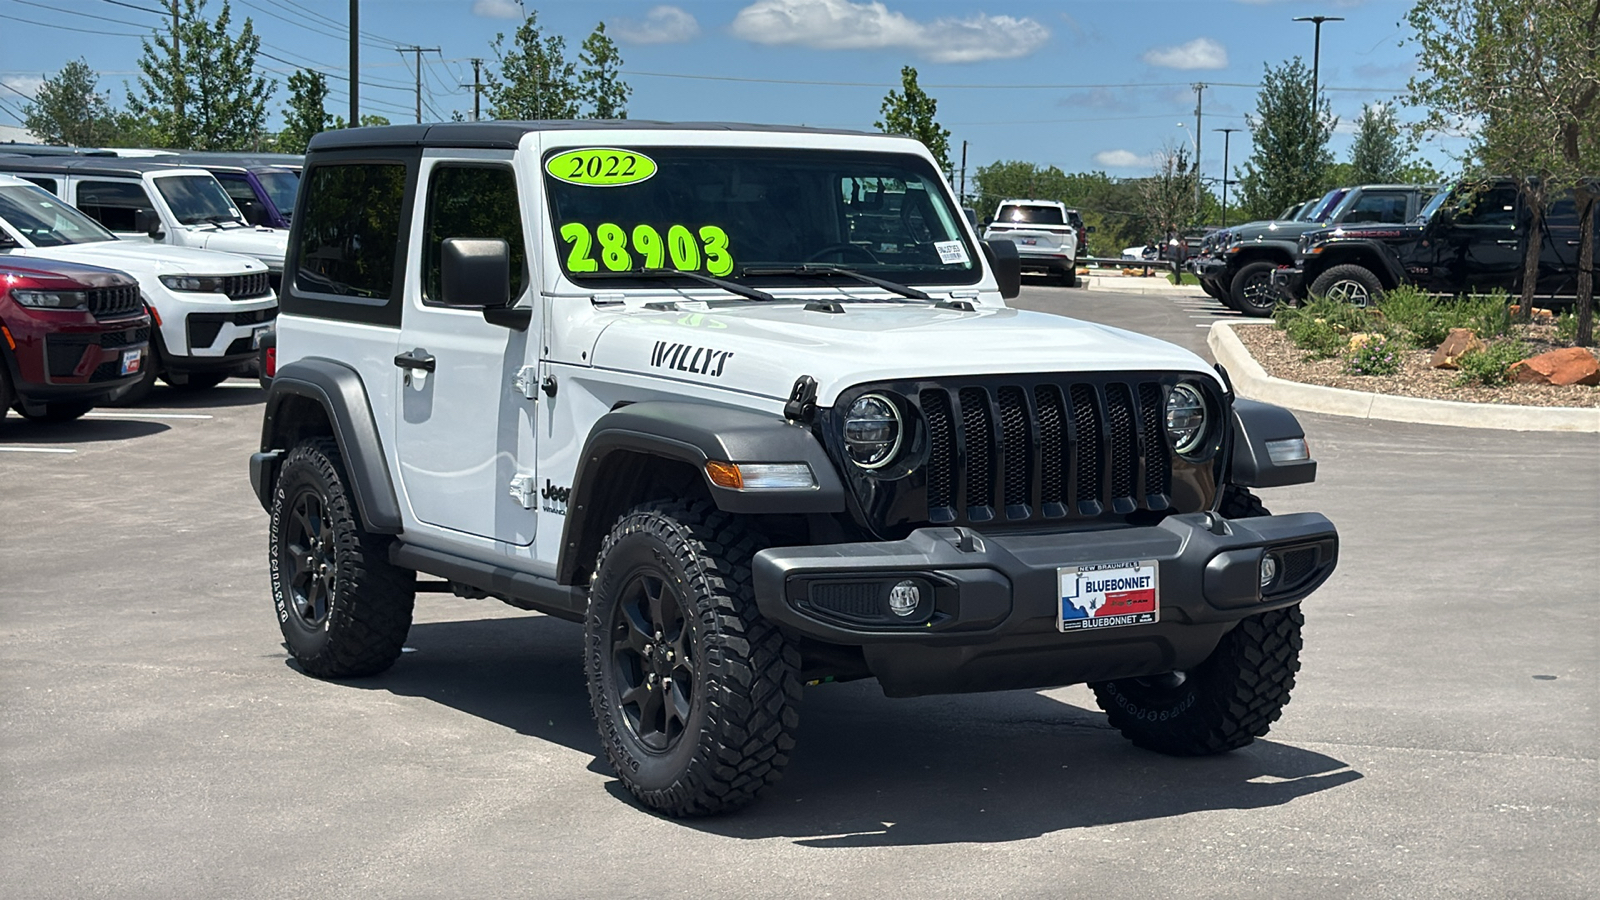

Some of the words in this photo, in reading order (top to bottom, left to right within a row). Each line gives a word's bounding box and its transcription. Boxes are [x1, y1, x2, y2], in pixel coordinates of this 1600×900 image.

[568, 155, 637, 178] 2022
[1328, 230, 1400, 238] UBICON
[560, 222, 734, 277] 28903
[651, 340, 734, 377] WILLYS
[1097, 562, 1138, 570] BRAUNFELS
[1085, 576, 1151, 593] BLUEBONNET
[1082, 615, 1137, 628] BLUEBONNET
